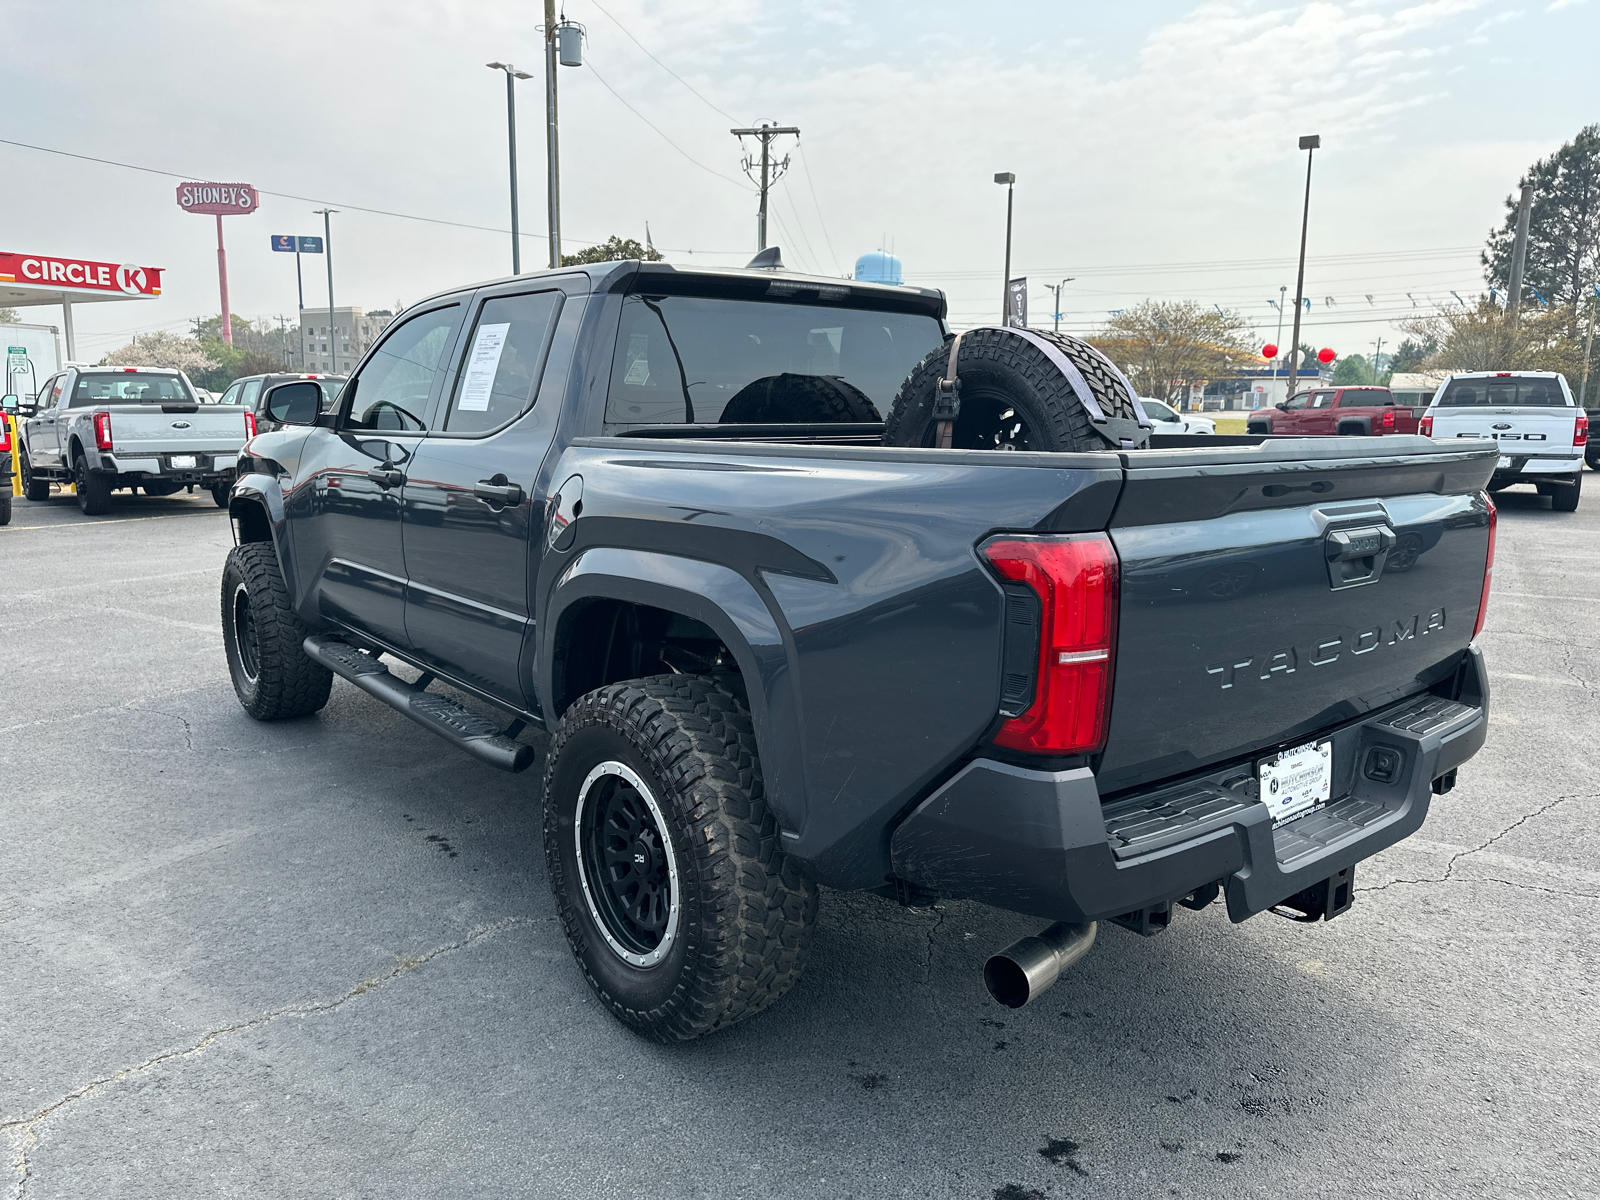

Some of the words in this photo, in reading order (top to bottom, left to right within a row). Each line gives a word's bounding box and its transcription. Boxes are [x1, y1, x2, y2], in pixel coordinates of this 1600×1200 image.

[181, 186, 251, 208] SHONEY'S
[21, 259, 111, 286] CIRCLE
[123, 268, 145, 293] K
[1350, 537, 1379, 551] TOYOTA
[1206, 606, 1446, 689] TACOMA
[1281, 763, 1324, 789] HUTCHINSON
[1291, 761, 1303, 769] GMC
[1281, 779, 1309, 796] AUTOMOTIVE
